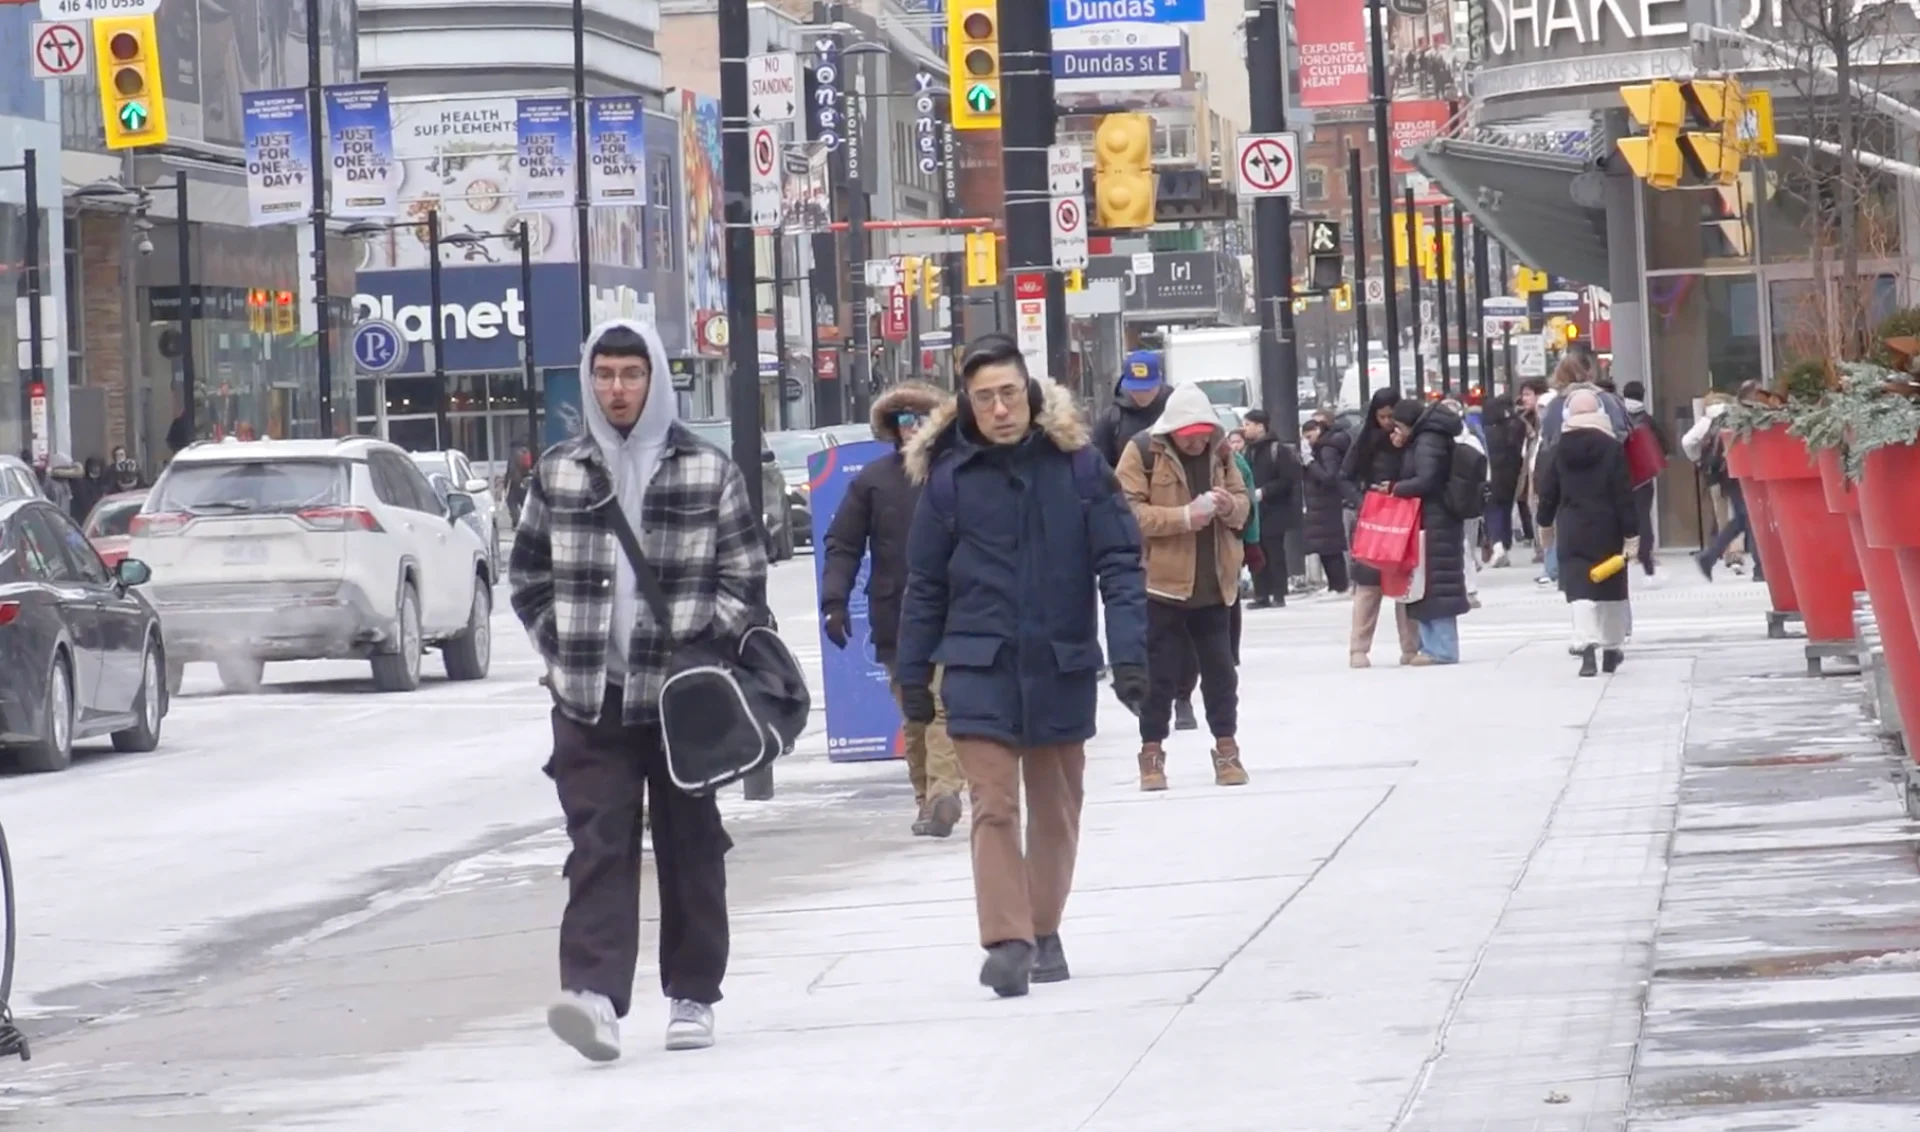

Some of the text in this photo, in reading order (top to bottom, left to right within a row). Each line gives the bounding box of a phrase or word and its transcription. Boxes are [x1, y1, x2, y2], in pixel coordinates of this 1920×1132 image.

[1066, 0, 1156, 21] Dundas
[1490, 0, 1688, 55] SHAKE
[1302, 42, 1355, 54] EXPLORE
[764, 57, 780, 73] NO
[1064, 51, 1168, 74] Dundas St E
[752, 77, 793, 95] STANDING
[1302, 76, 1341, 88] HEART
[441, 109, 499, 123] HEALTH
[251, 134, 290, 148] JUST
[335, 129, 374, 141] JUST
[521, 135, 555, 145] JUST
[595, 133, 627, 143] JUST
[848, 95, 859, 178] DOWNTOWN
[343, 141, 374, 154] FOR
[527, 146, 554, 156] FOR
[600, 144, 626, 154] FOR
[1059, 147, 1070, 159] NO
[258, 148, 289, 161] FOR
[334, 154, 366, 168] ONE
[592, 154, 618, 165] ONE
[249, 160, 282, 175] ONE
[519, 156, 546, 167] ONE
[347, 168, 376, 181] DAY
[529, 167, 555, 178] DAY
[603, 165, 627, 175] DAY
[263, 172, 292, 187] DAY
